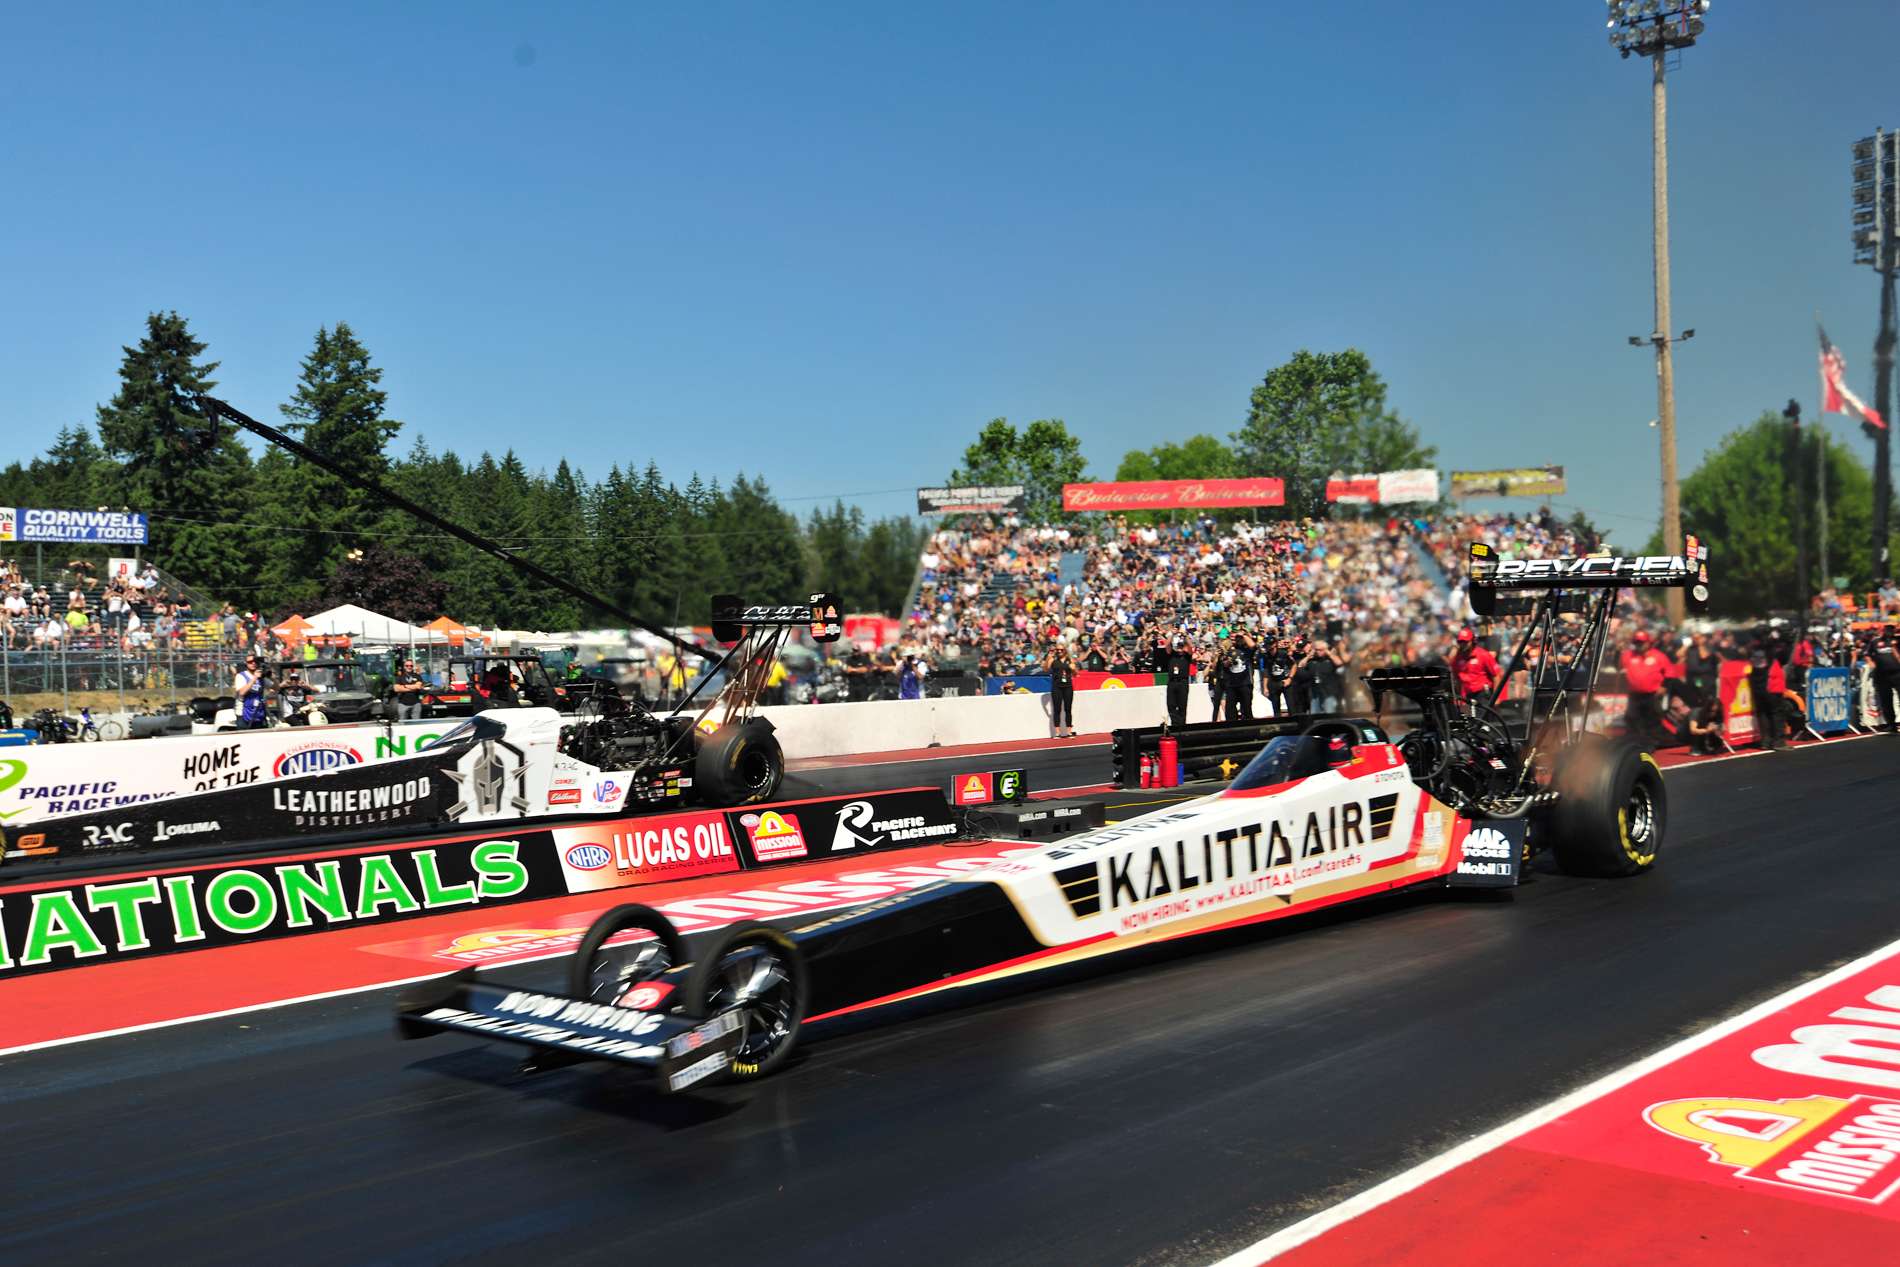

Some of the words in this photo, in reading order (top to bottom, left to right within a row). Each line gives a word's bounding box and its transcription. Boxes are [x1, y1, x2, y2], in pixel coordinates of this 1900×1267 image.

[25, 509, 145, 528] CORNWELL
[23, 525, 91, 538] QUALITY
[95, 528, 146, 540] TOOLS
[1812, 676, 1847, 698] CAMPING
[1813, 698, 1848, 722] WORLD
[184, 744, 241, 779] HOME
[223, 766, 261, 790] THE
[19, 781, 117, 800] PACIFIC
[273, 776, 431, 813] LEATHERWOOD
[47, 791, 176, 814] RACEWA
[295, 805, 413, 827] DISTILLERY
[871, 816, 925, 833] PACIFIC
[82, 822, 135, 847] RAC
[890, 823, 957, 842] RACEWAYS
[1461, 827, 1511, 850] MAC
[570, 846, 609, 868] NHRA
[613, 826, 691, 870] LUCAS
[694, 822, 732, 859] OIL
[1107, 819, 1294, 910] KALITTA
[1301, 800, 1366, 859] AIR
[1460, 848, 1511, 859] TOOLS
[617, 867, 650, 878] DRAG
[652, 861, 696, 873] RACING
[697, 856, 735, 867] SERIES
[1457, 861, 1496, 876] Mobil
[0, 840, 530, 968] ATIONALS
[494, 991, 572, 1019] NOW
[555, 1000, 667, 1037] HIRING
